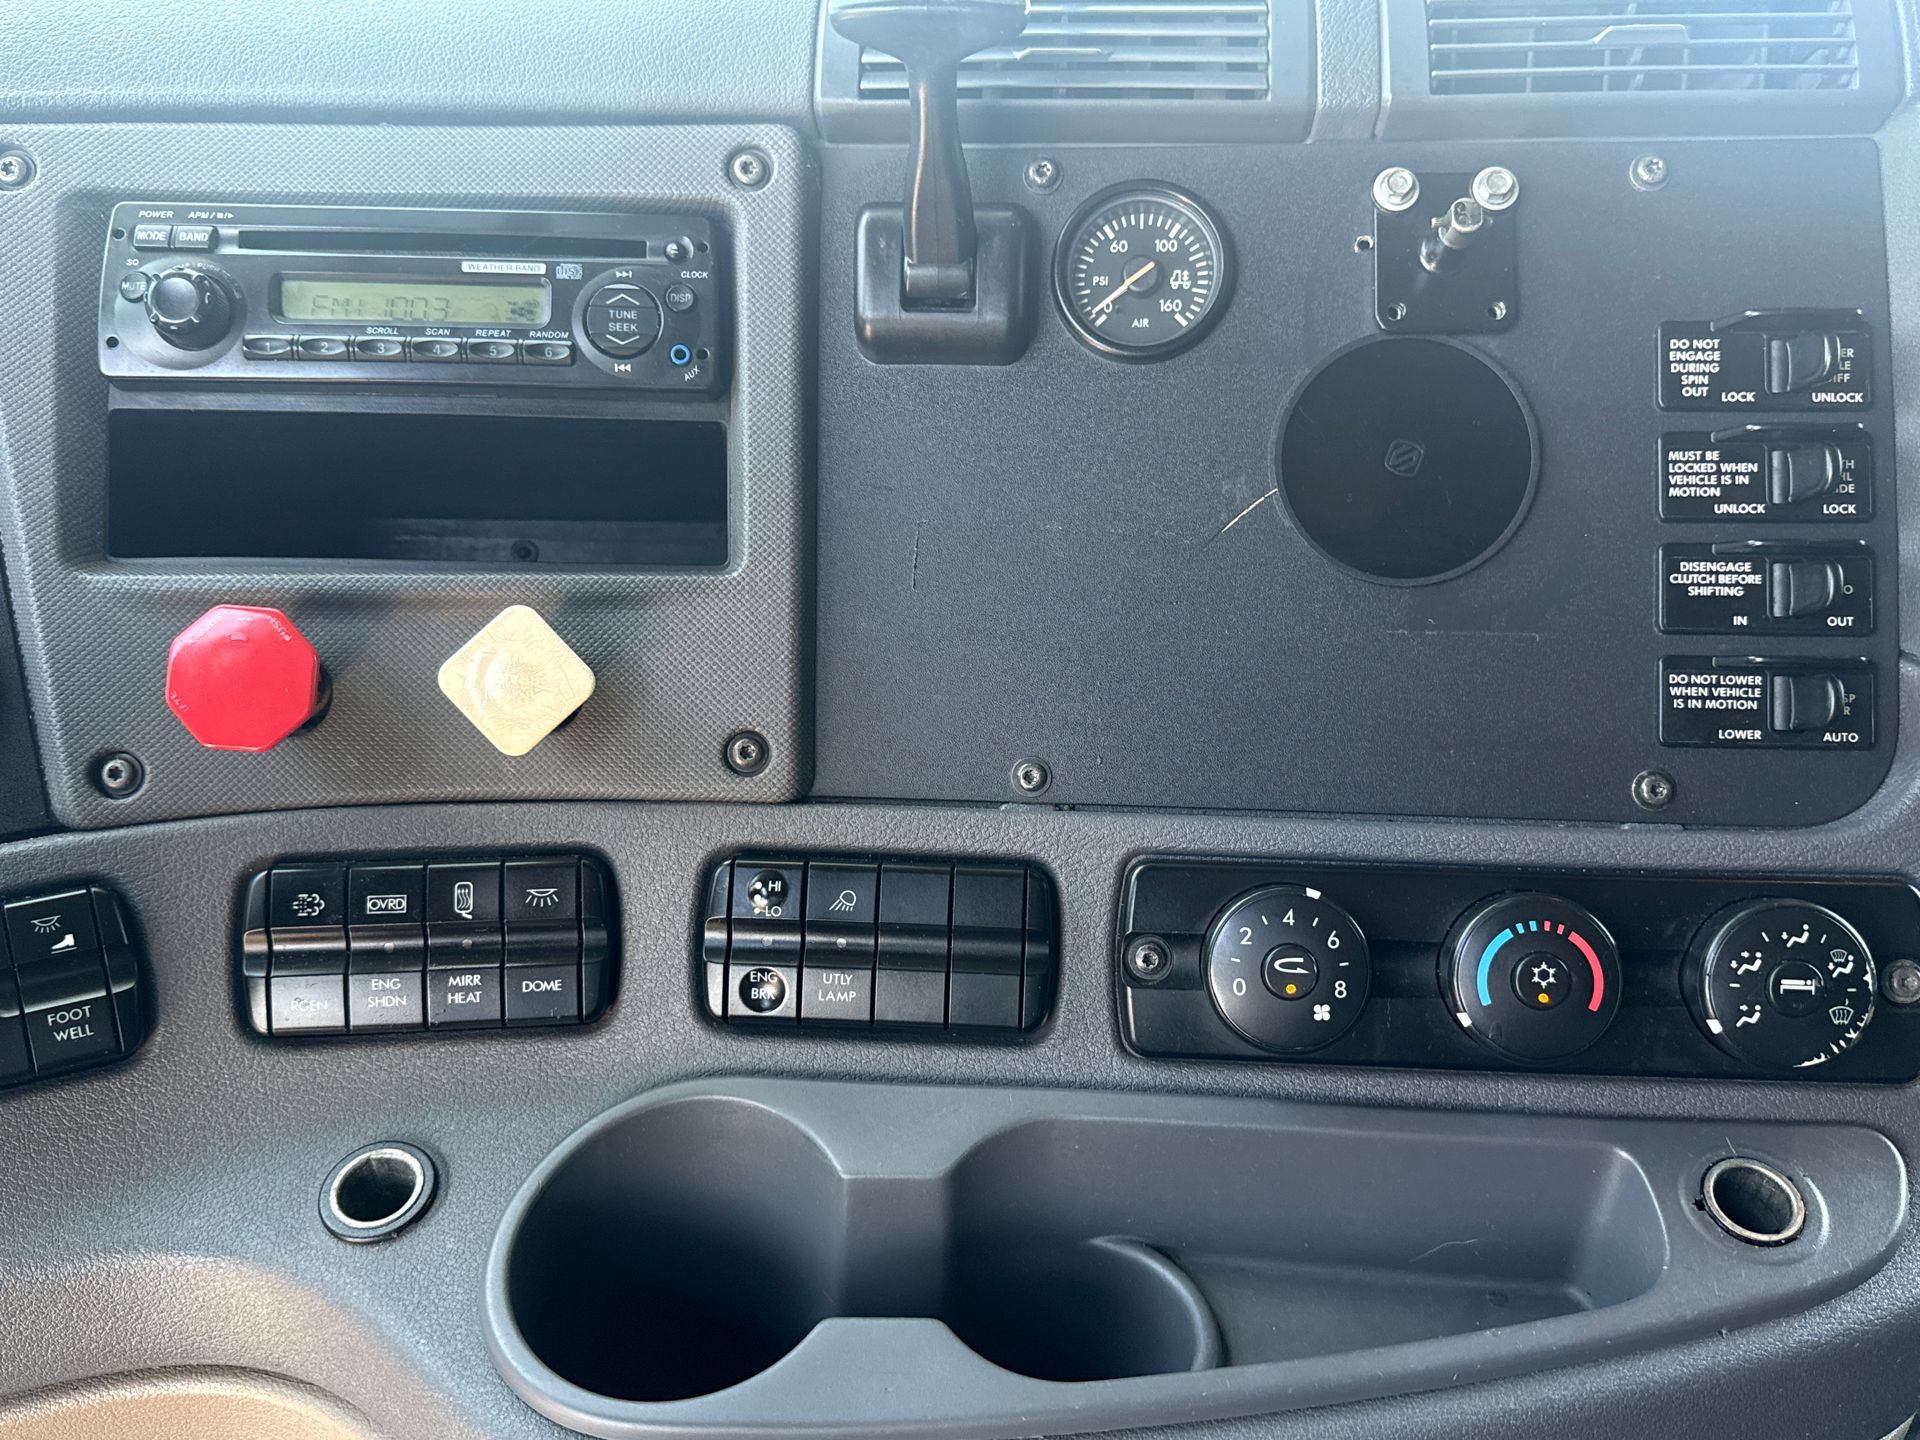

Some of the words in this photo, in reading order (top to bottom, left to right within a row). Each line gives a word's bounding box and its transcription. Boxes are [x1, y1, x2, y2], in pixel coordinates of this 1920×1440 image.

[138, 210, 174, 218] POWER
[137, 231, 167, 241] MODE
[179, 232, 209, 242] BAND
[1109, 240, 1128, 253] 60
[1154, 239, 1178, 253] 100
[467, 263, 513, 272] WEATHER
[515, 263, 541, 273] BAND
[681, 271, 709, 279] CLOCK
[121, 281, 146, 291] MUTE
[1092, 276, 1109, 286] PSI
[669, 292, 692, 303] DISP
[1103, 301, 1113, 313] 0
[1159, 299, 1182, 312] 160
[608, 310, 638, 320] TUNE
[608, 322, 638, 332] SEEK
[1131, 318, 1150, 328] AIR
[366, 327, 399, 335] SCROLL
[425, 328, 451, 336] SCAN
[475, 329, 512, 338] REPEAT
[529, 331, 569, 339] RANDOM
[264, 342, 271, 352] 1
[320, 342, 328, 353] 2
[377, 343, 385, 354] 3
[432, 344, 441, 355] 4
[1669, 339, 1690, 350] DO
[1692, 339, 1721, 350] NOT
[489, 346, 497, 356] 5
[545, 347, 553, 358] 6
[1669, 351, 1721, 362] ENGAGE
[683, 365, 701, 382] AUX
[1670, 363, 1720, 374] DURING
[1681, 375, 1709, 385] SPIN
[1681, 387, 1709, 397] OUT
[1721, 391, 1756, 403] LOCK
[1812, 392, 1864, 403] UNLOCK
[1668, 451, 1702, 461] MUST
[1705, 451, 1720, 461] BE
[1669, 463, 1717, 473] LOCKED
[1720, 463, 1758, 473] WHEN
[1668, 475, 1717, 485] VEHICLE
[1720, 475, 1732, 485] IS
[1735, 475, 1749, 485] IN
[1669, 487, 1721, 497] MOTION
[1714, 503, 1766, 514] UNLOCK
[1822, 504, 1857, 514] LOCK
[1680, 562, 1752, 572] DISENGAGE
[1669, 574, 1716, 584] CLUTCH
[1718, 574, 1762, 585] BEFORE
[1687, 586, 1744, 597] SHIFTING
[1733, 616, 1748, 626] IN
[1826, 616, 1854, 627] OUT
[1669, 674, 1689, 685] DO
[1691, 675, 1718, 685] NOT
[1720, 675, 1763, 686] LOWER
[1669, 687, 1708, 697] WHEN
[1712, 687, 1761, 698] VEHICLE
[1673, 699, 1685, 709] IS
[1688, 699, 1702, 709] IN
[1705, 699, 1758, 710] MOTION
[1718, 729, 1762, 740] LOWER
[1823, 732, 1859, 743] AUTO
[768, 881, 782, 892] HI
[368, 898, 406, 911] OVRD
[765, 906, 782, 917] LO
[1282, 909, 1295, 926] 4
[1239, 927, 1253, 945] 2
[1327, 930, 1340, 949] 6
[448, 974, 482, 986] MIRR
[750, 971, 778, 983] ENG
[823, 973, 853, 986] UTLY
[371, 978, 401, 990] ENG
[522, 979, 562, 992] DOME
[1232, 978, 1246, 995] 0
[1334, 980, 1347, 999] 8
[447, 991, 482, 1004] HEAT
[751, 987, 776, 1000] BRK
[818, 990, 857, 1002] LAMP
[290, 999, 328, 1012] RGEN
[367, 995, 407, 1008] SHDN
[47, 1005, 92, 1026] FOOT
[53, 1024, 94, 1042] WELL
